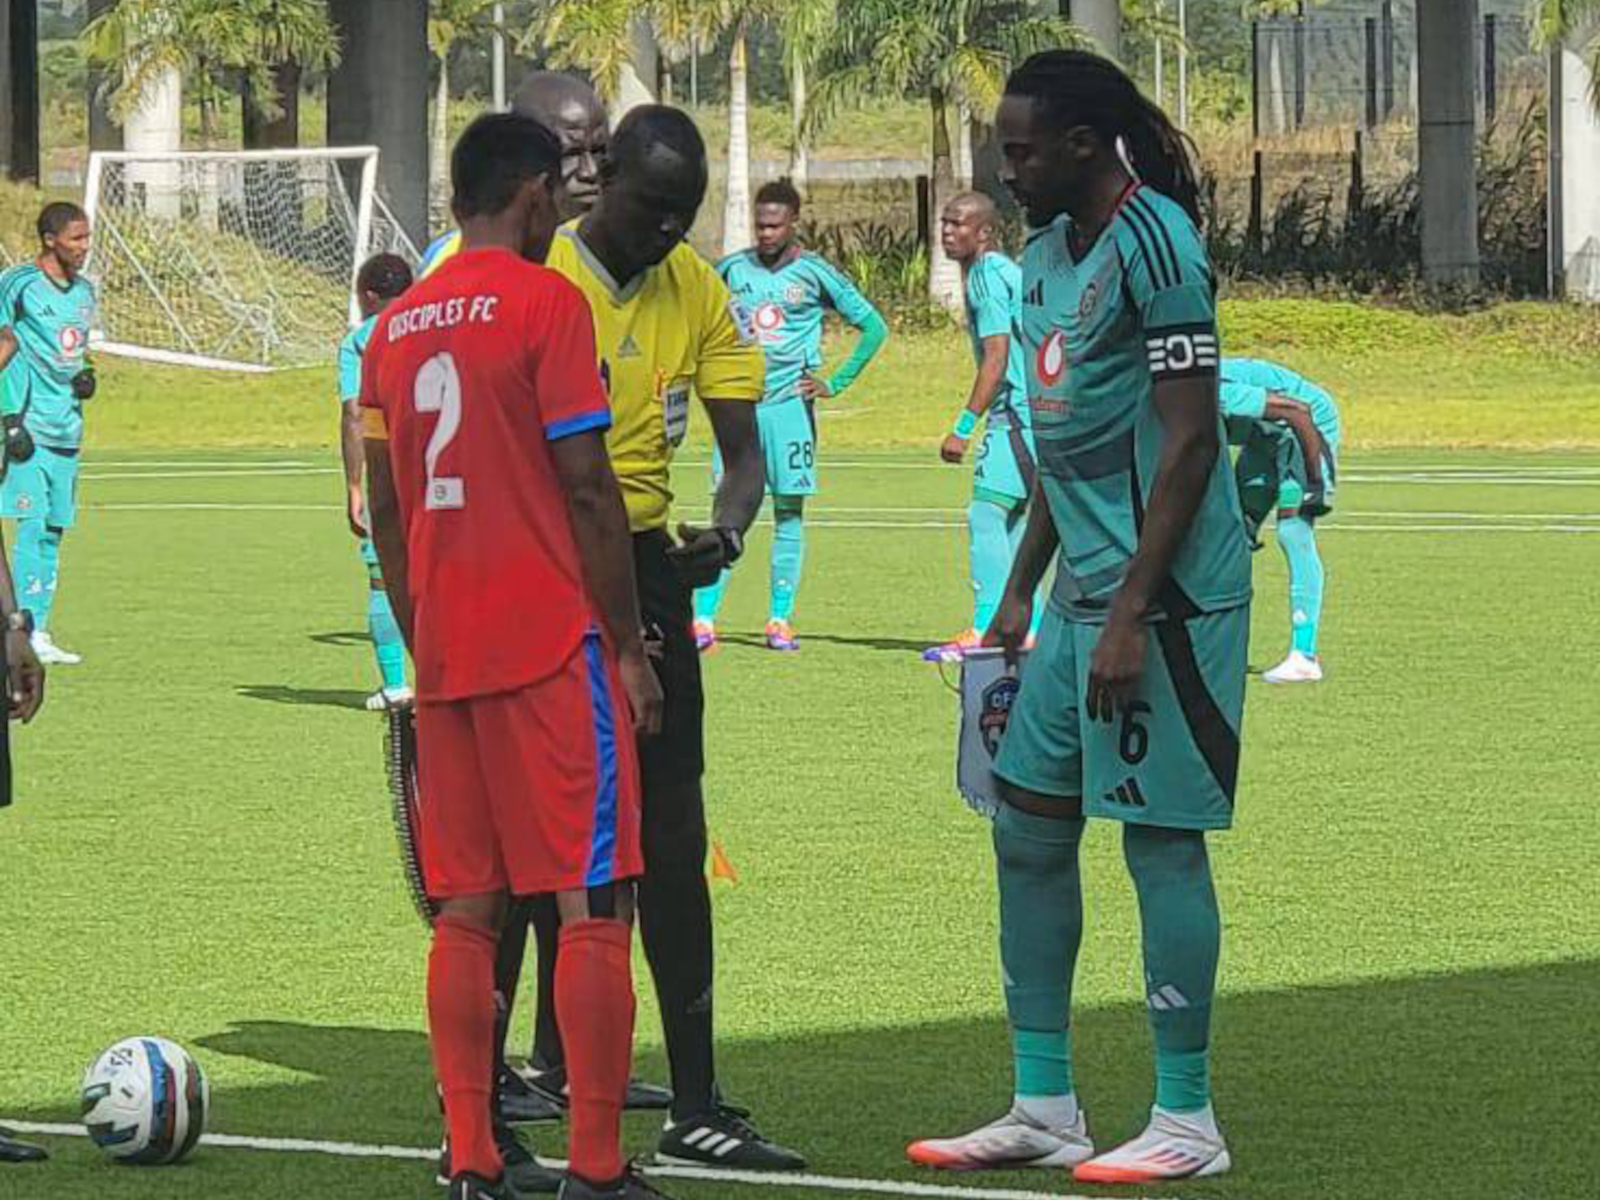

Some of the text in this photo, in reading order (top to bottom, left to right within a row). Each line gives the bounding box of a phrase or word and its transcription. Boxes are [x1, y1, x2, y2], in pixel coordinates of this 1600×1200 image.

[468, 296, 498, 322] FC
[414, 351, 465, 510] 2
[788, 441, 814, 470] 28
[1119, 702, 1151, 765] 6
